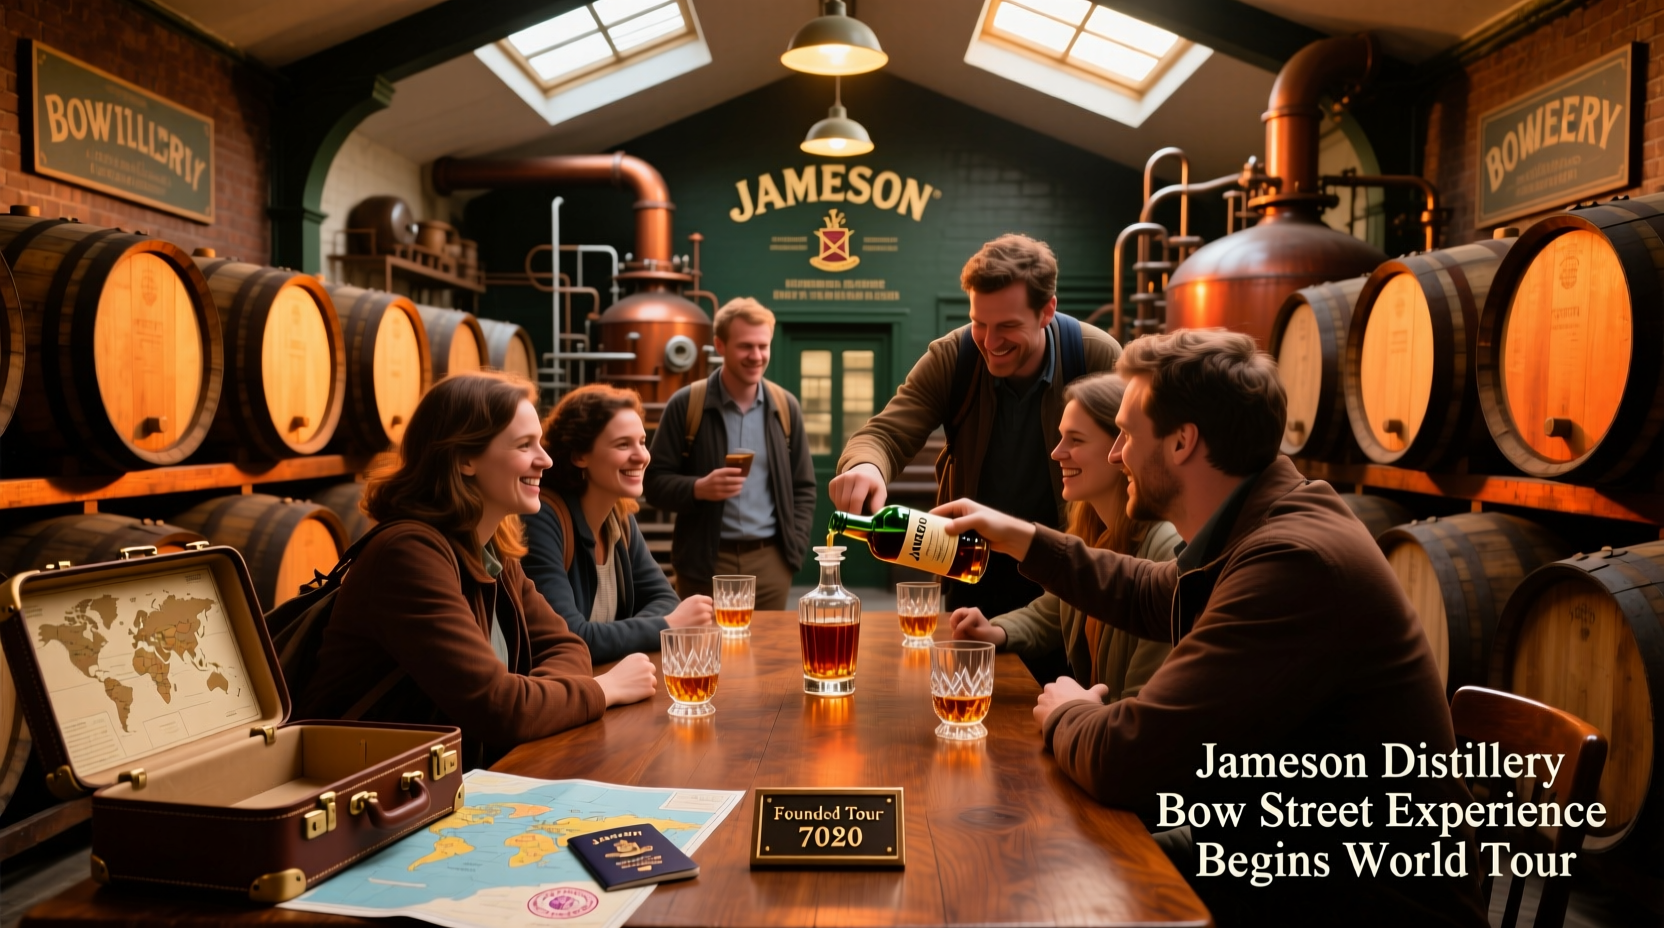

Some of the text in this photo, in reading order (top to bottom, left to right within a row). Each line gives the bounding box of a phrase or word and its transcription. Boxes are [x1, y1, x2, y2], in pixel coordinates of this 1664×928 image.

[1485, 95, 1623, 193] BOWEERY
[845, 806, 884, 821] Tour
[798, 826, 863, 848] 7020
